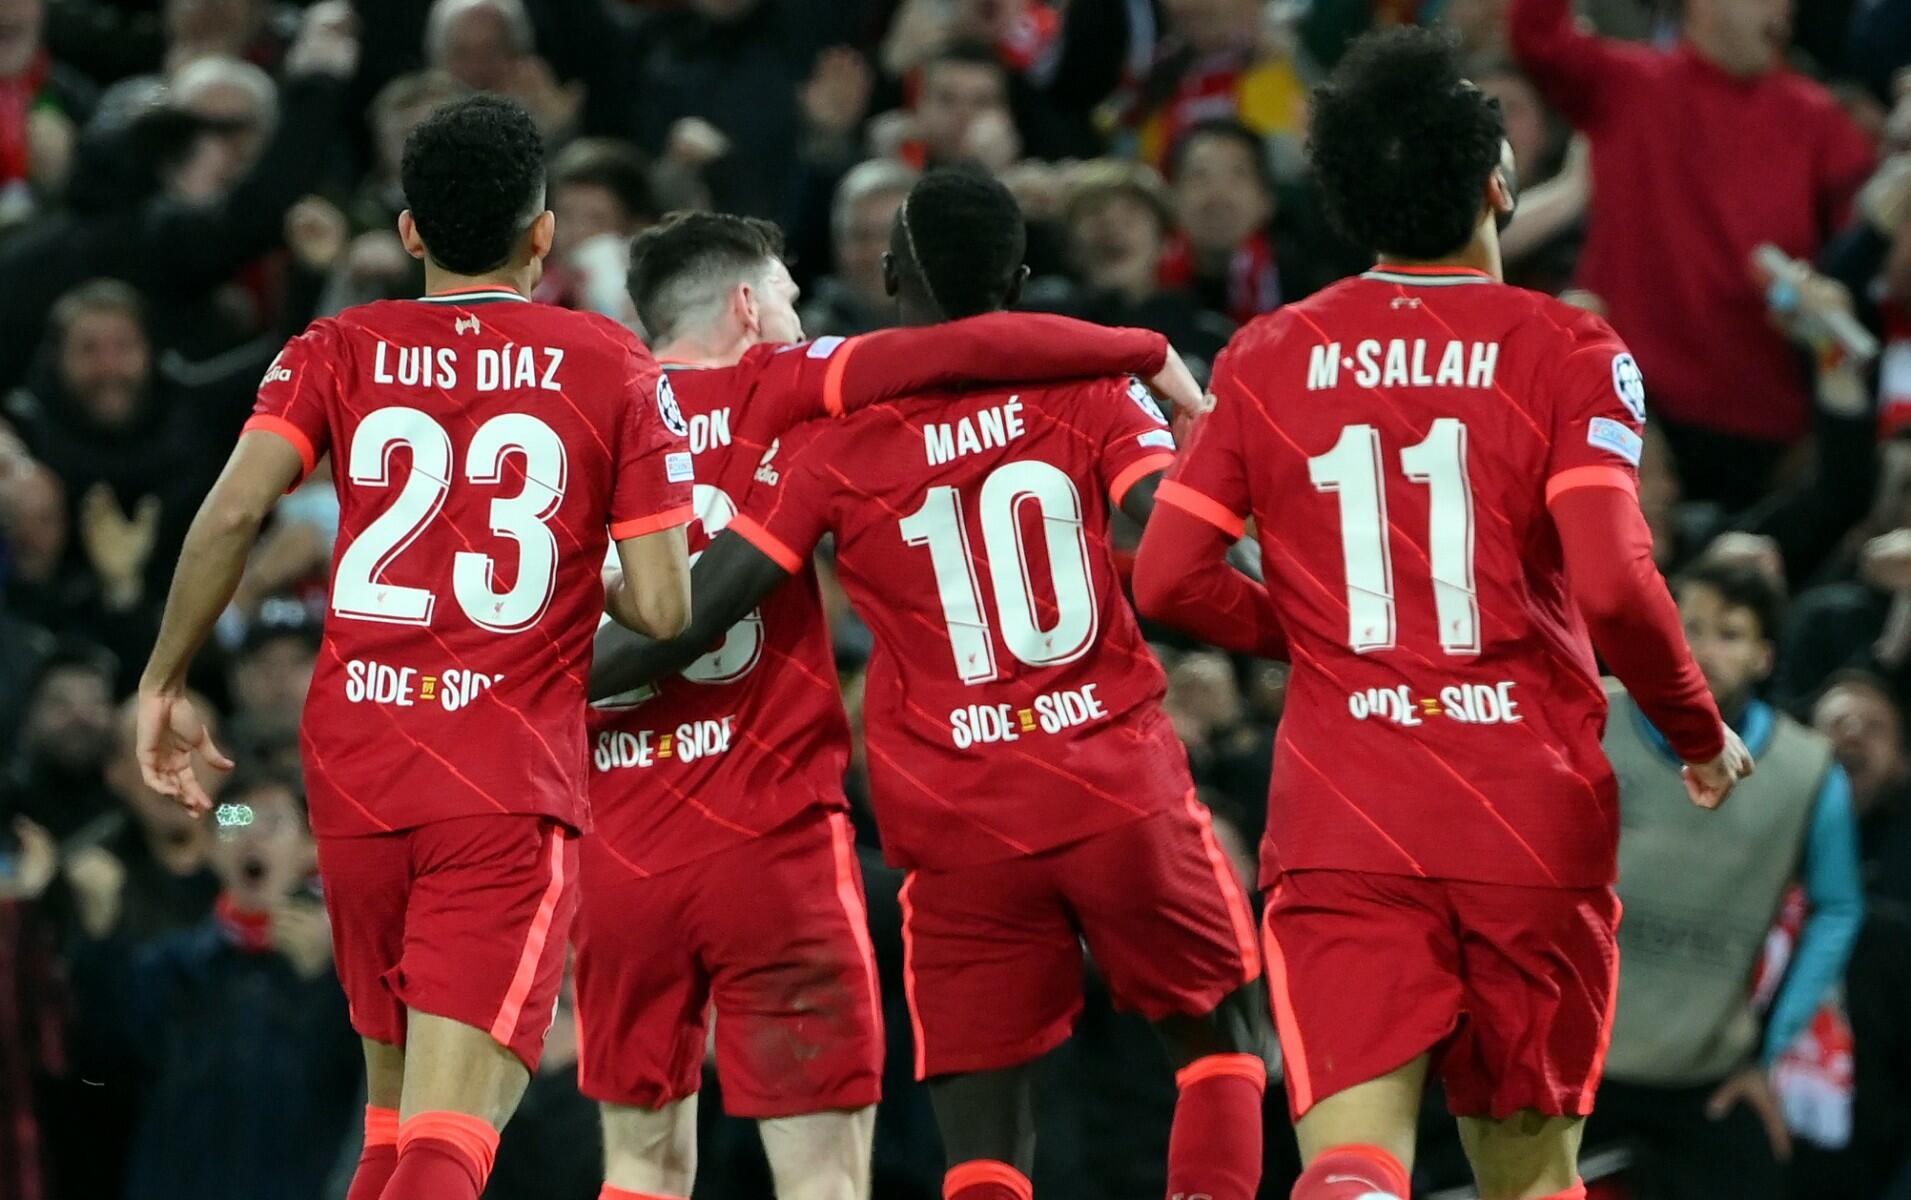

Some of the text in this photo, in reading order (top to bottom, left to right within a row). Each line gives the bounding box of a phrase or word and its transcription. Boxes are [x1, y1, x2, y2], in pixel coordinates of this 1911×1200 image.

[374, 341, 564, 391] LUIS DÍAZ
[923, 395, 1026, 467] MANÉ
[332, 406, 568, 634] 23
[1308, 418, 1481, 655] 11
[900, 460, 1099, 685] 10
[346, 660, 418, 706] SIDE
[441, 669, 505, 711] SID
[950, 703, 1020, 750] SIDE
[1034, 683, 1109, 735] SIDE
[1440, 682, 1524, 724] SIDE
[594, 730, 655, 772] SIDE
